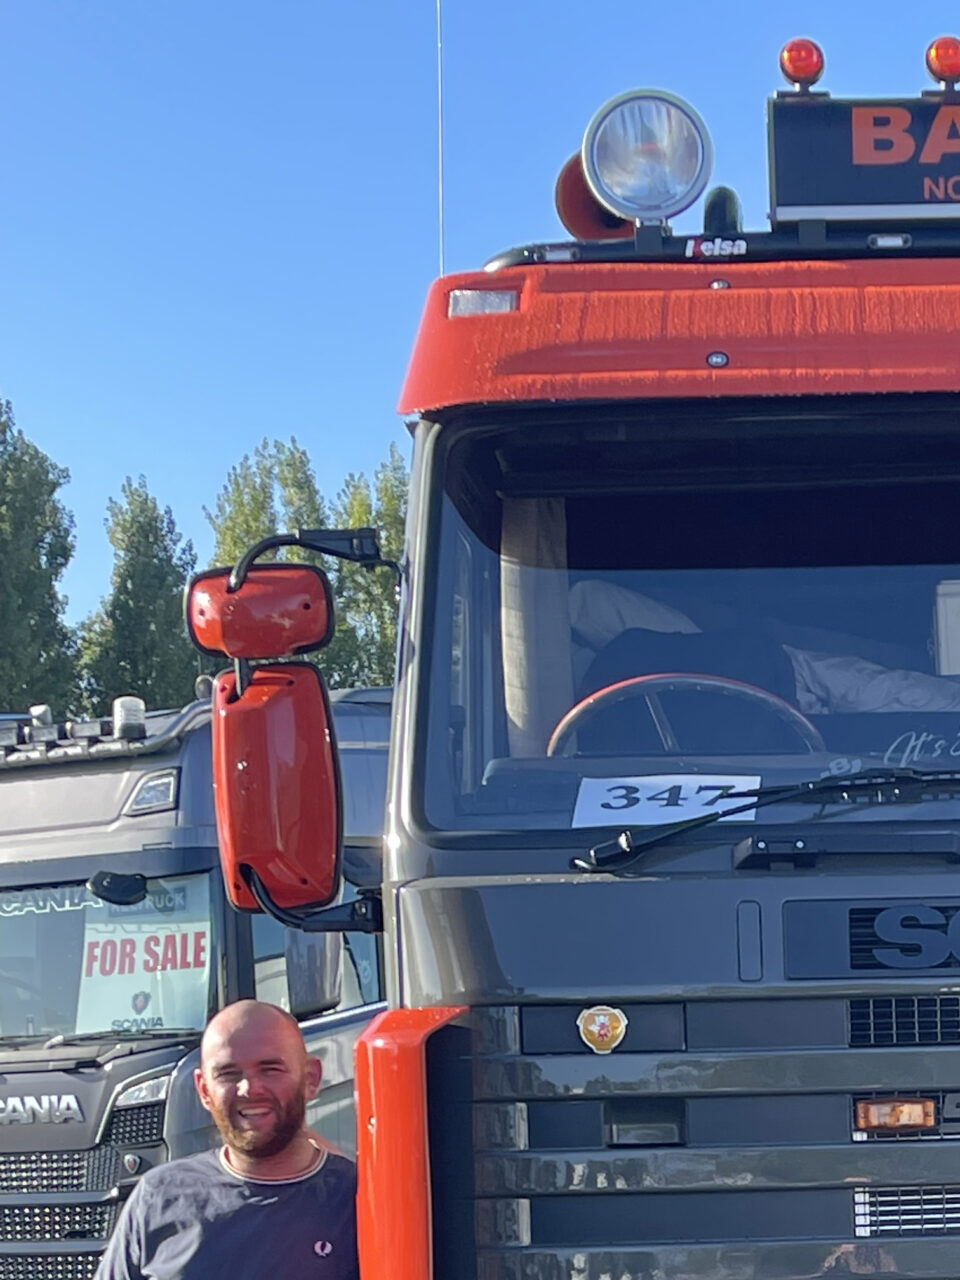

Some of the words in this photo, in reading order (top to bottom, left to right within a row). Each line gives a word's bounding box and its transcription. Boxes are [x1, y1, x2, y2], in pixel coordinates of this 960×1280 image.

[601, 785, 735, 810] 347
[85, 938, 136, 977] FOR
[143, 931, 207, 973] SALE
[111, 1016, 164, 1030] SCANIA
